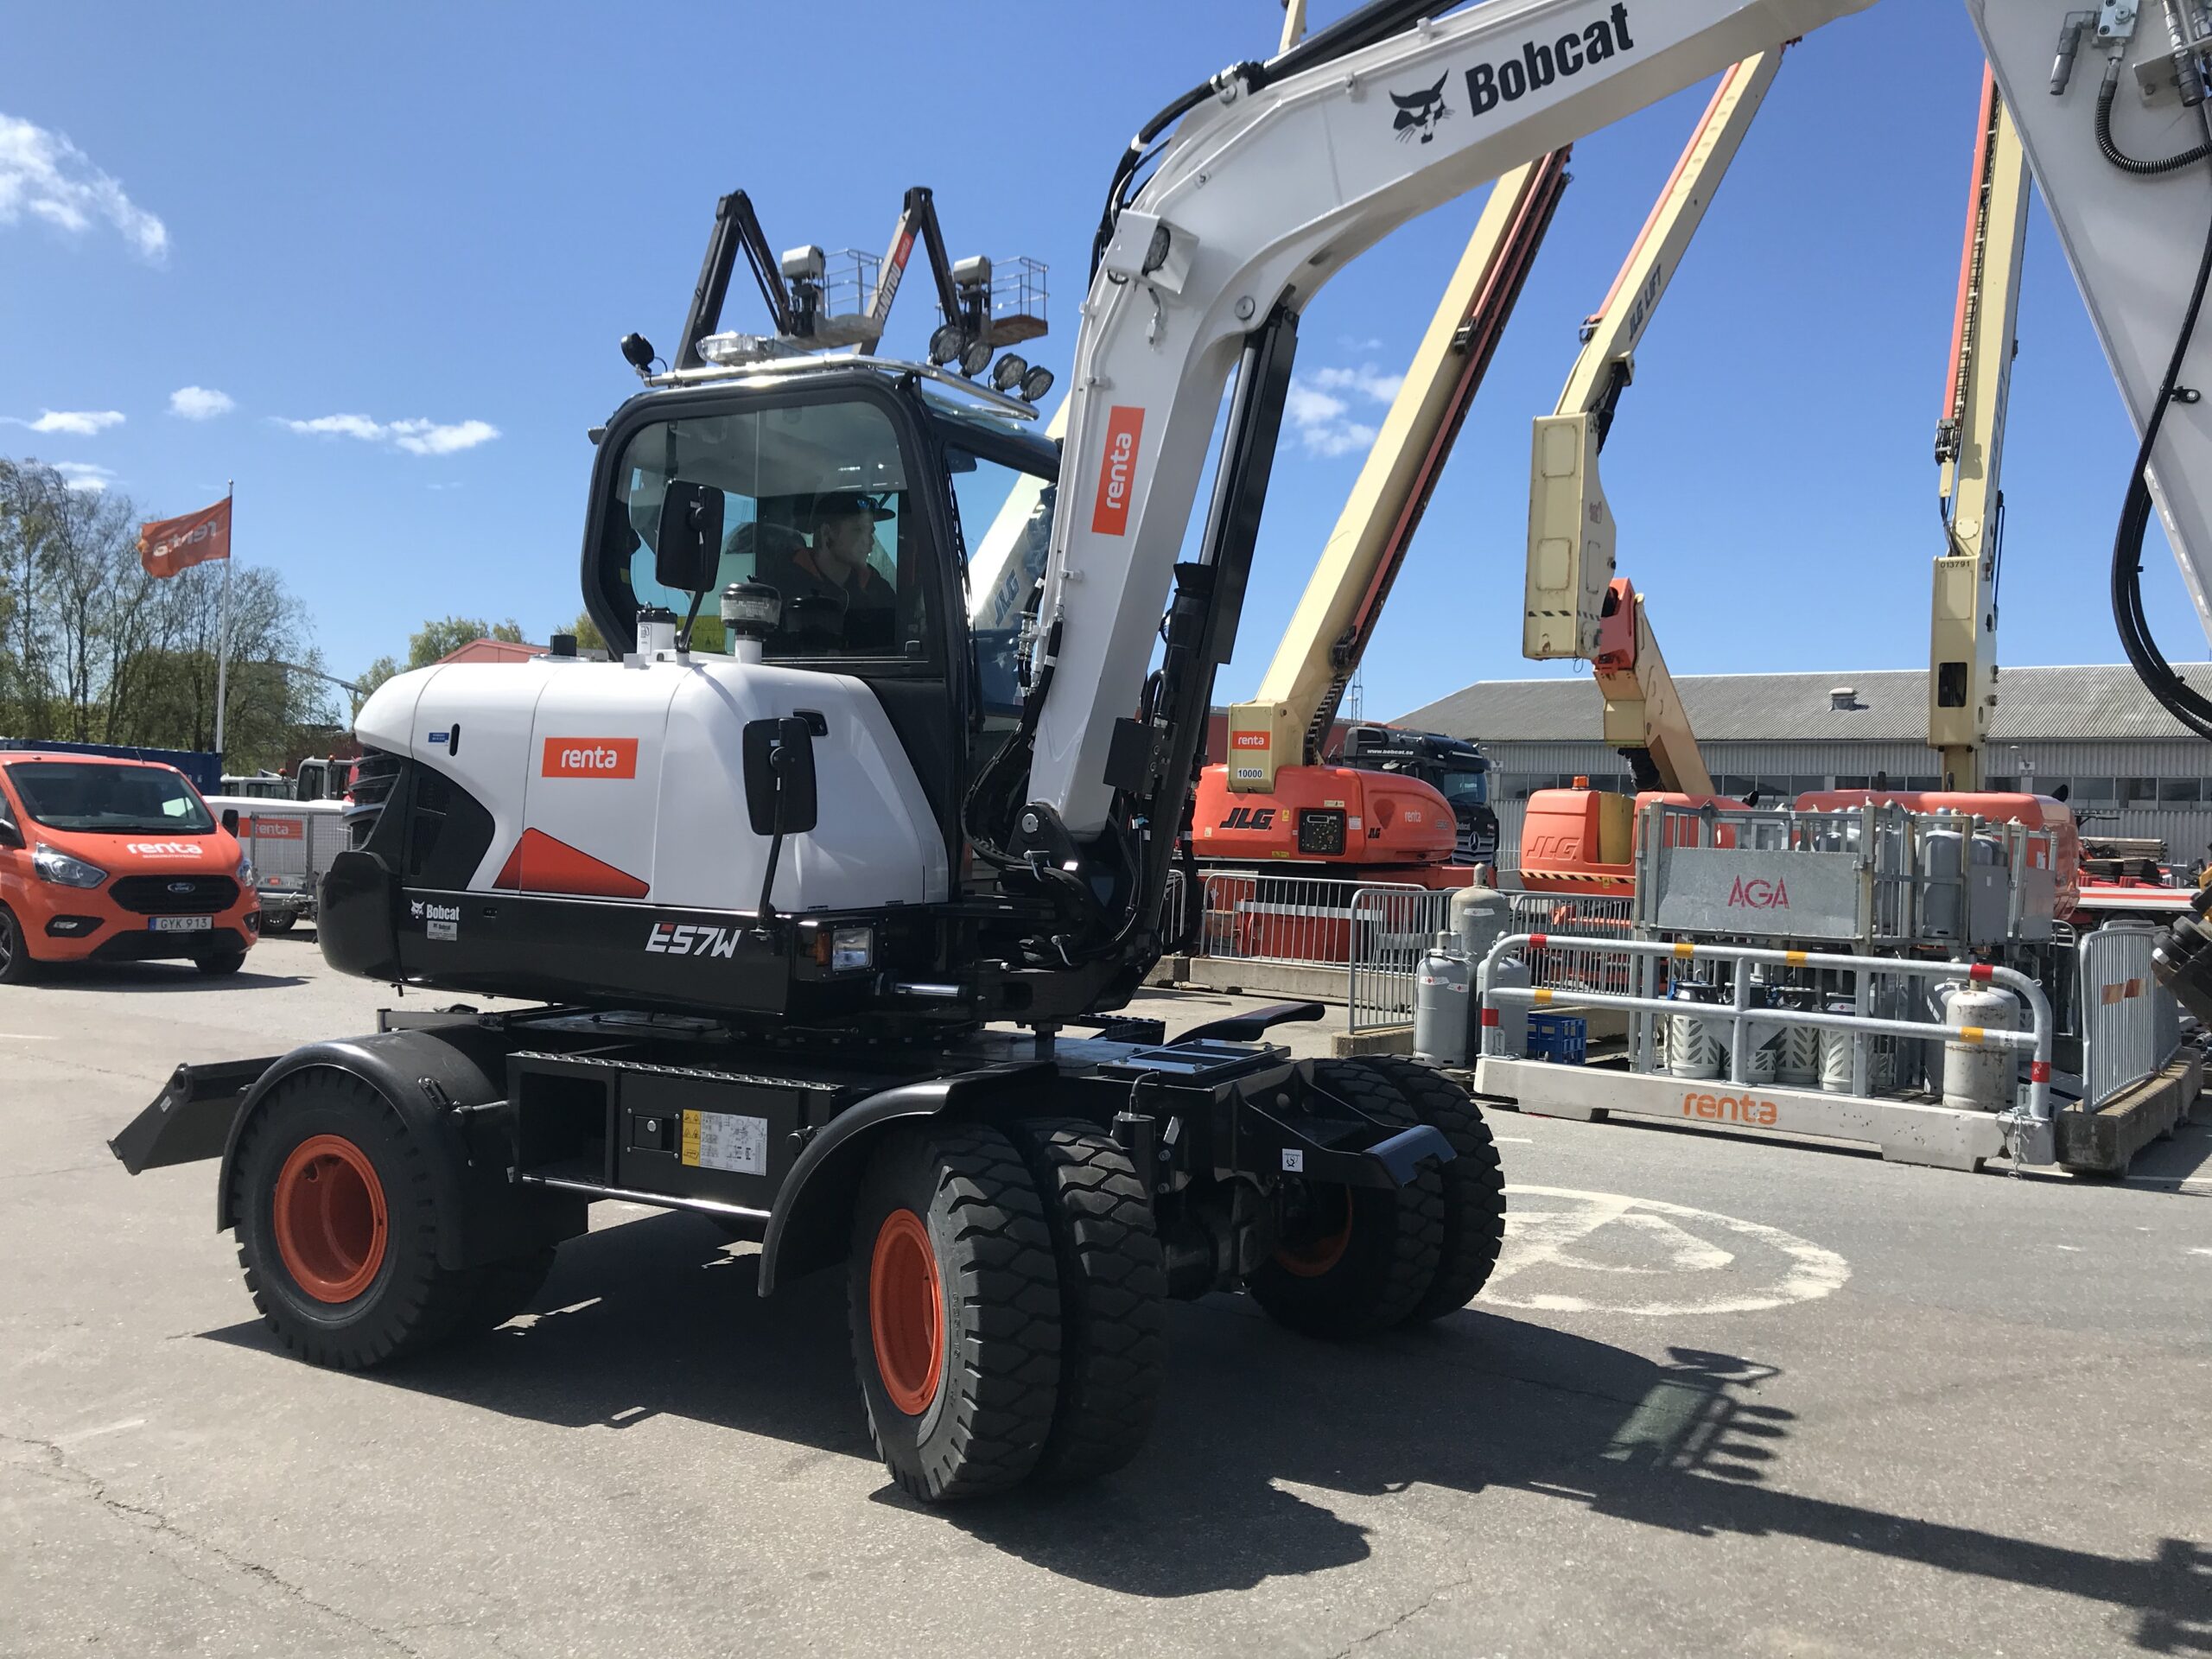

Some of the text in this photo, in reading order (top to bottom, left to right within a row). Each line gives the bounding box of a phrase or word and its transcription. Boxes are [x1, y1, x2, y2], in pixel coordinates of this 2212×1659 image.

[1465, 2, 1633, 117] Bobcat
[1644, 264, 1661, 310] LIFT
[1106, 433, 1132, 509] renta
[1940, 560, 1970, 569] 013791
[995, 568, 1020, 627] JLG
[1237, 735, 1265, 746] renta
[561, 746, 618, 769] renta
[1238, 769, 1262, 779] 10000
[1219, 807, 1276, 830] JLG
[1405, 810, 1421, 823] renta
[256, 823, 289, 835] renta
[126, 842, 203, 855] renta
[1526, 836, 1580, 861] JLG
[1728, 874, 1789, 909] AGA
[161, 918, 207, 930] GYK 913
[426, 904, 460, 921] Bobcat
[645, 923, 742, 959] E57W
[1683, 1092, 1777, 1124] renta
